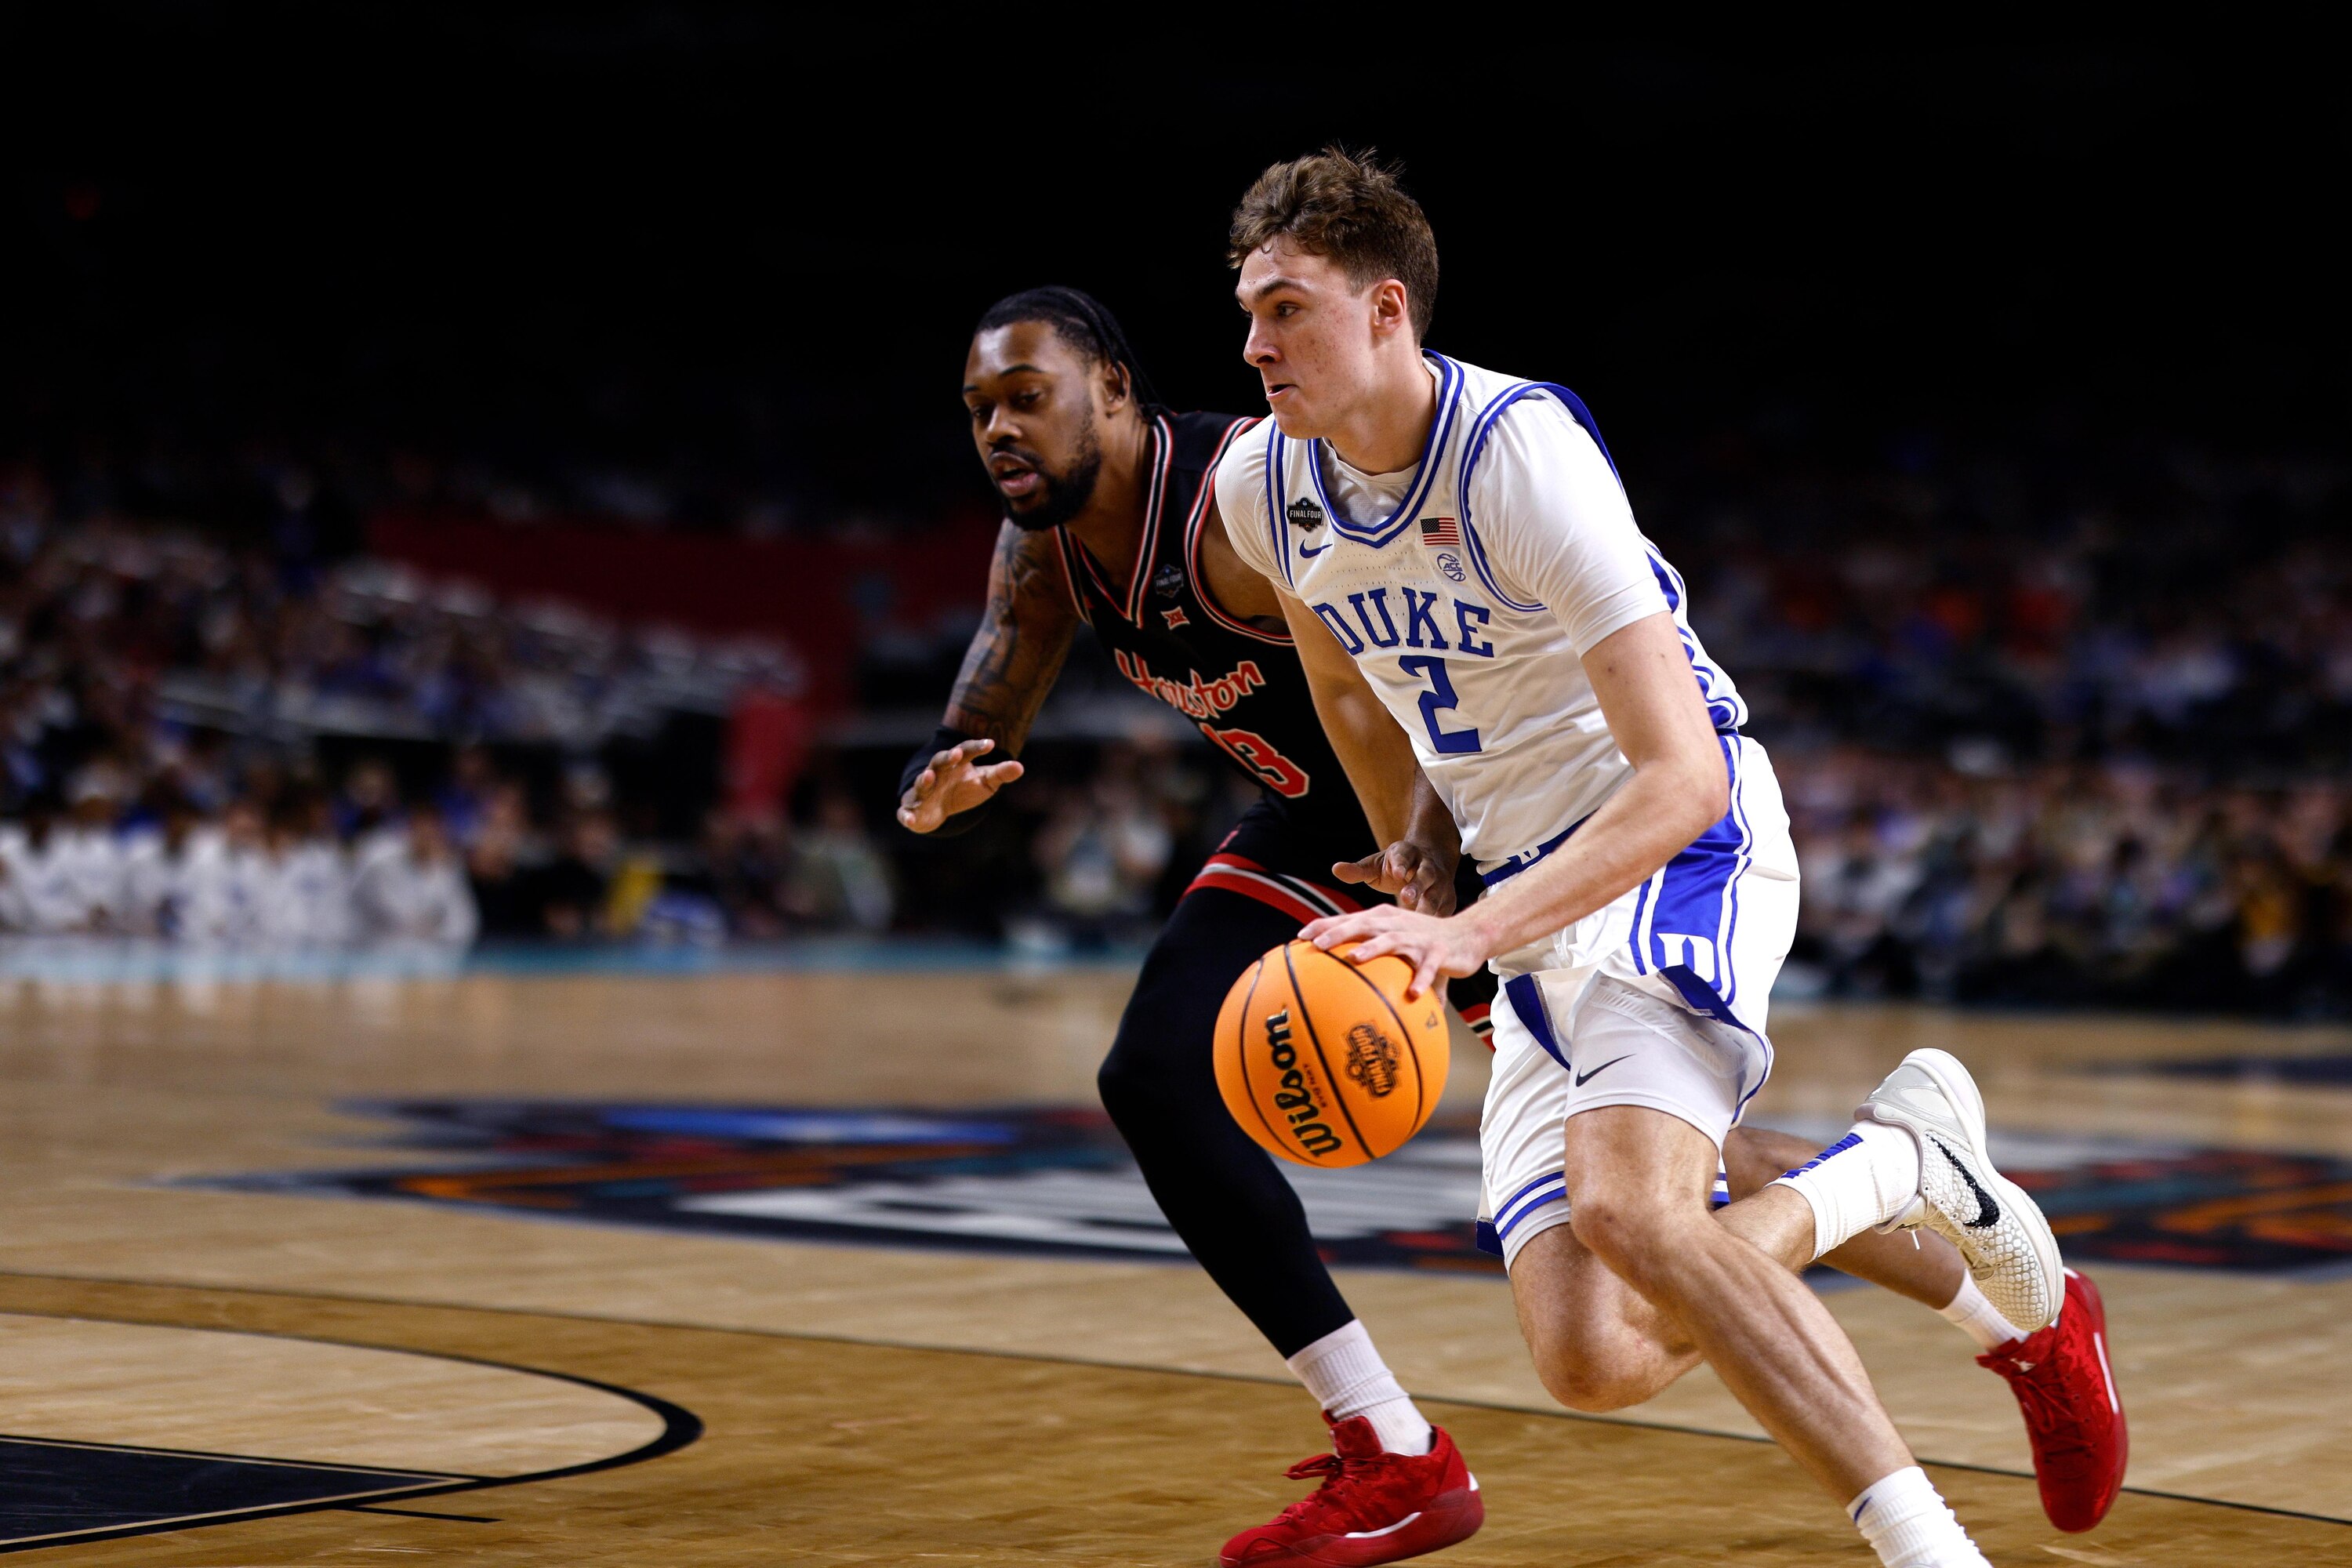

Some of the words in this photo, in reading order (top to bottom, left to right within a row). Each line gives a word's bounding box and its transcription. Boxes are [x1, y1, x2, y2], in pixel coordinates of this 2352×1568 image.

[1312, 586, 1494, 658] DUKE
[1114, 648, 1267, 720] Houston
[1399, 655, 1482, 753] 2
[1265, 1008, 1342, 1157] Wilson
